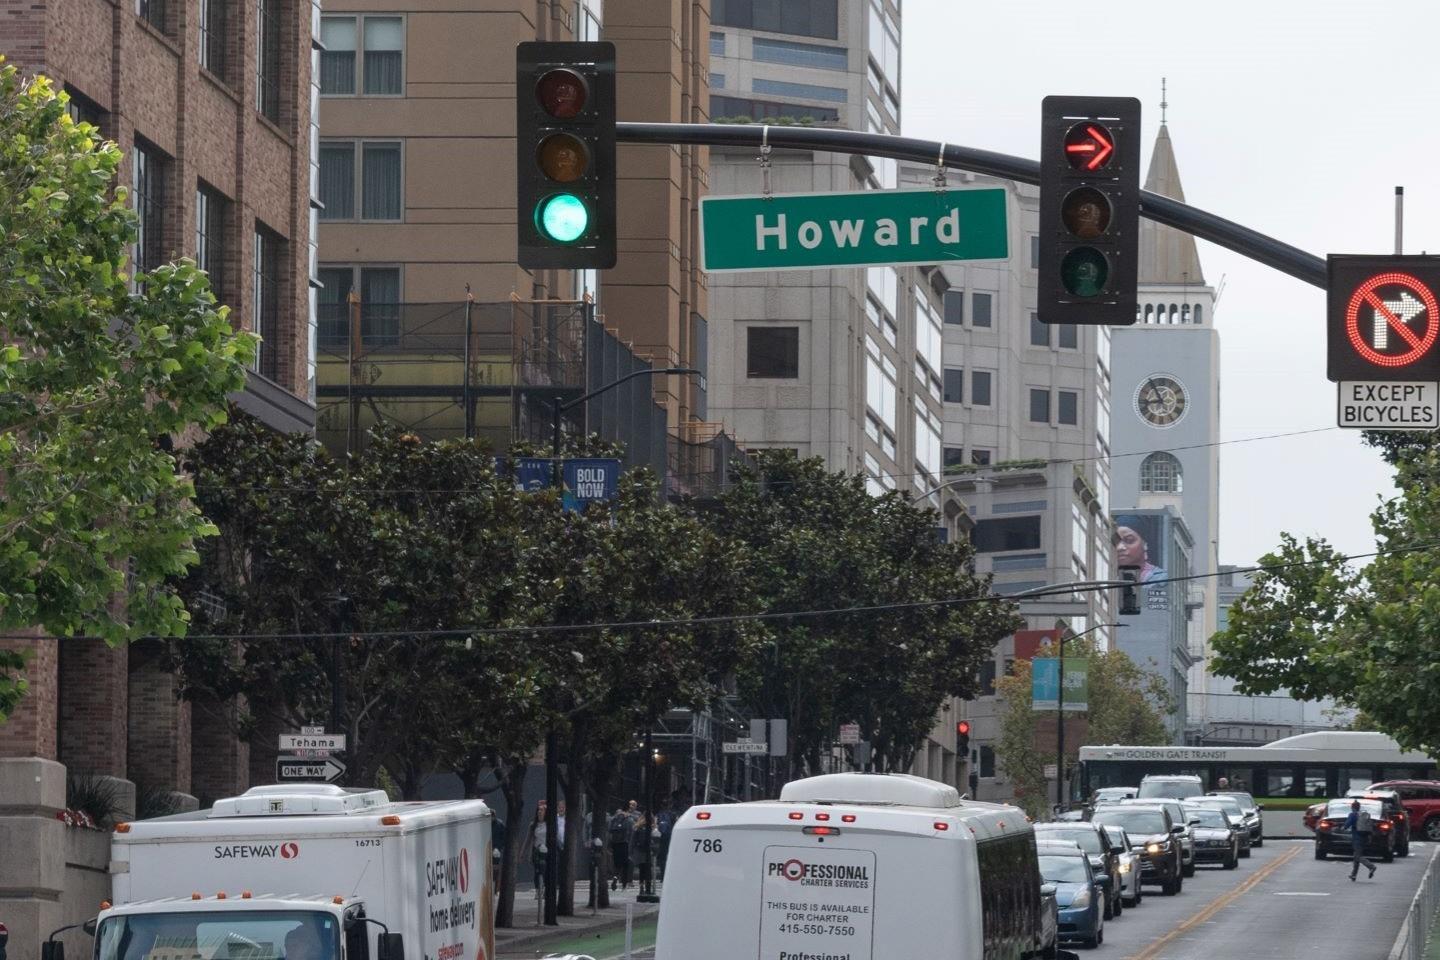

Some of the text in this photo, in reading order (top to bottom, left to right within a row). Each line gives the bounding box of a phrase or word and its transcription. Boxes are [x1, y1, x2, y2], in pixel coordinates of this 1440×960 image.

[755, 207, 960, 251] Howard
[1353, 385, 1425, 401] EXCEPT
[1344, 406, 1433, 422] BICYCLES
[577, 468, 604, 482] BOLD
[577, 483, 604, 498] NOW
[290, 738, 335, 747] Tehama
[1126, 750, 1164, 759] GOLDEN
[1166, 750, 1189, 759] GATE
[1191, 750, 1226, 759] TRANSIT
[284, 767, 325, 776] ONE WAY
[214, 844, 279, 858] SAFEWAY
[693, 839, 722, 853] 786
[426, 855, 459, 898] SAFEWAY
[768, 859, 868, 882] PROFESSIONAL
[800, 878, 869, 889] CHARTER SERVICES
[767, 901, 869, 914] THIS BUS IS AVAILABLE
[430, 897, 475, 934] home delivery
[786, 913, 849, 923] FOR CHARTER
[779, 924, 855, 936] 415-550-7550
[779, 951, 850, 960] Professional
